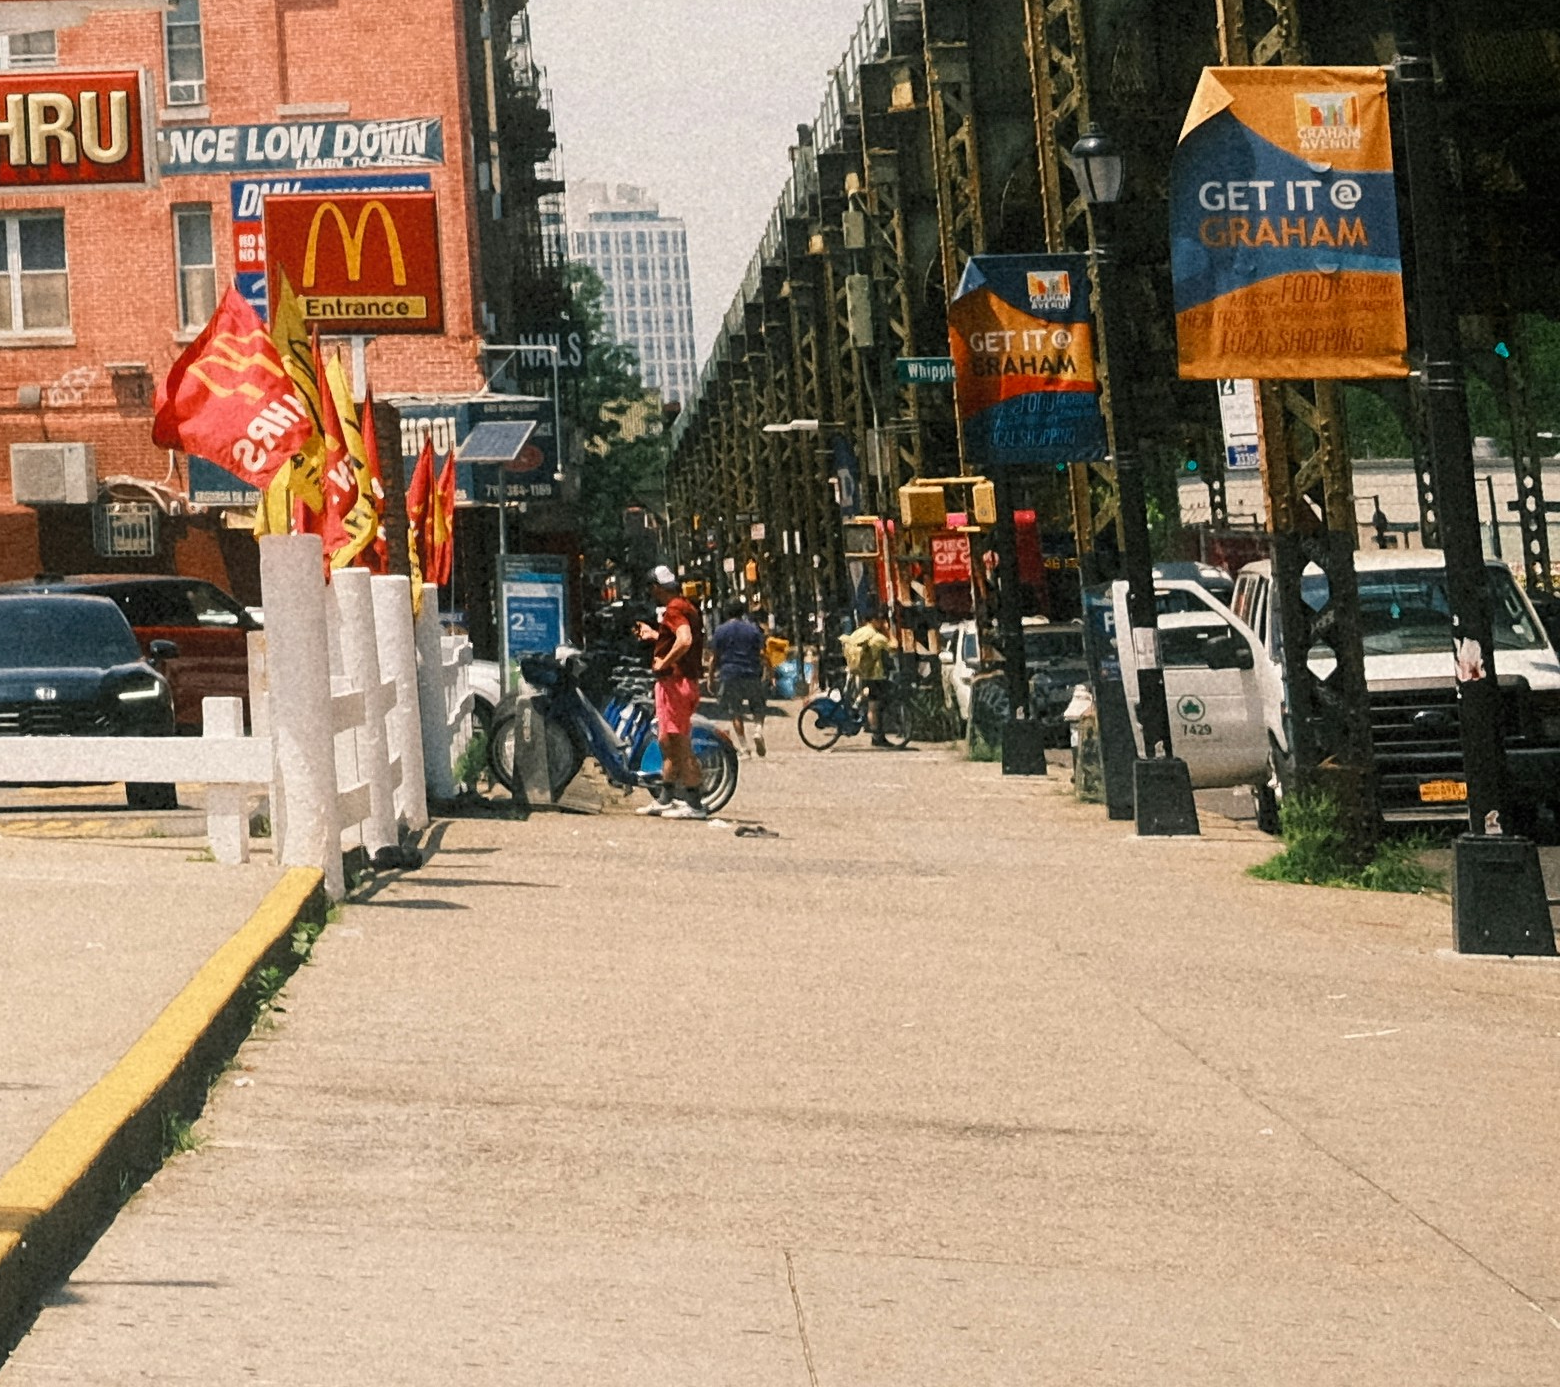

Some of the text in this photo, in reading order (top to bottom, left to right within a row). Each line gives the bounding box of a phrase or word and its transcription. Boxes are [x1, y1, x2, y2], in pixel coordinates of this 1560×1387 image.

[158, 119, 427, 164] NCE LOW DOWN
[1297, 127, 1361, 140] GRAHAM
[1300, 138, 1361, 150] AVENUE
[1198, 180, 1275, 212] GET
[1286, 180, 1322, 211] IT
[1199, 216, 1369, 249] GRAHAM
[1281, 274, 1332, 303] FOOD
[306, 297, 410, 318] Entrance
[520, 331, 582, 368] NAILS
[970, 331, 1016, 353] GET
[1023, 330, 1047, 352] IT
[1223, 327, 1365, 354] LOCAL SHOPPING
[907, 363, 957, 382] Whipple
[970, 355, 1077, 377] GRAHAM
